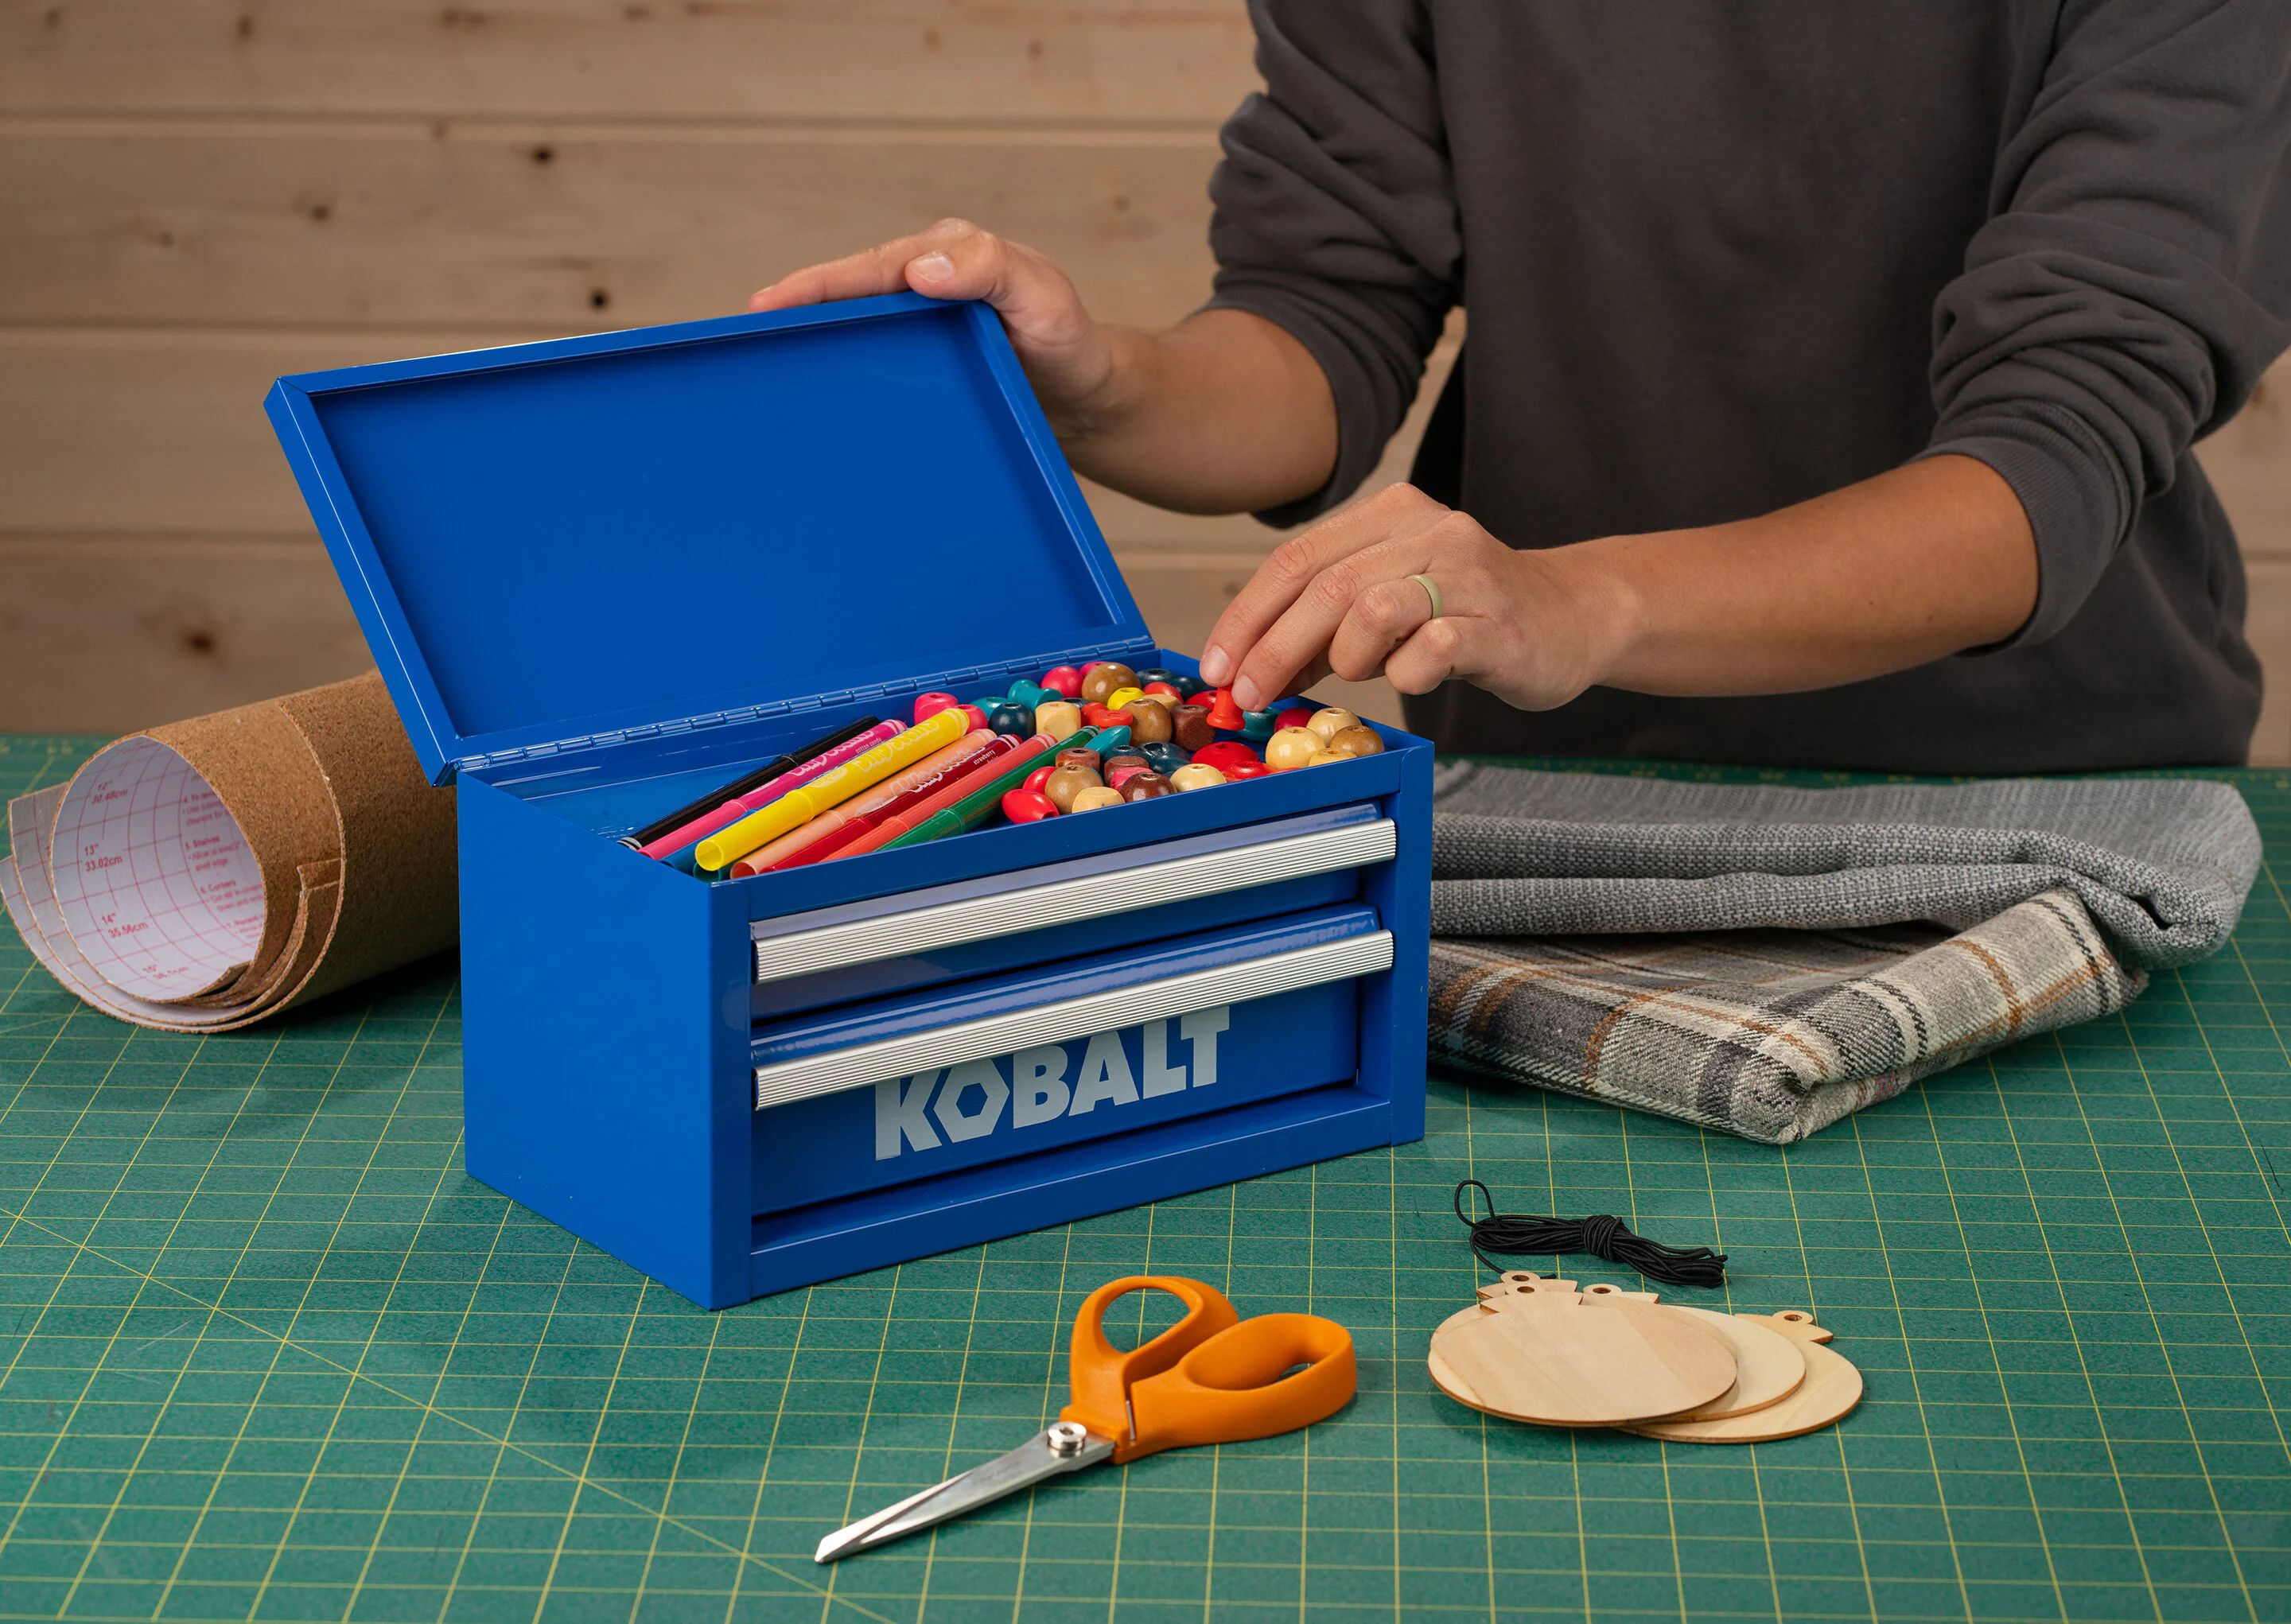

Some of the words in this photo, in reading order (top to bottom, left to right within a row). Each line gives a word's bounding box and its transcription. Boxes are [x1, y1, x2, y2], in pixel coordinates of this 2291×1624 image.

[855, 743, 870, 754] cotton
[869, 737, 882, 748] candy
[973, 750, 995, 765] strawberry
[97, 780, 113, 791] 12"
[193, 836, 220, 848] Shelves
[84, 843, 99, 857] 13"
[85, 855, 123, 872] 33.02cm
[208, 880, 236, 892] Corners
[101, 912, 115, 926] 14"
[108, 922, 149, 938] 35.56cm
[875, 1006, 1230, 1161] KOBALT
